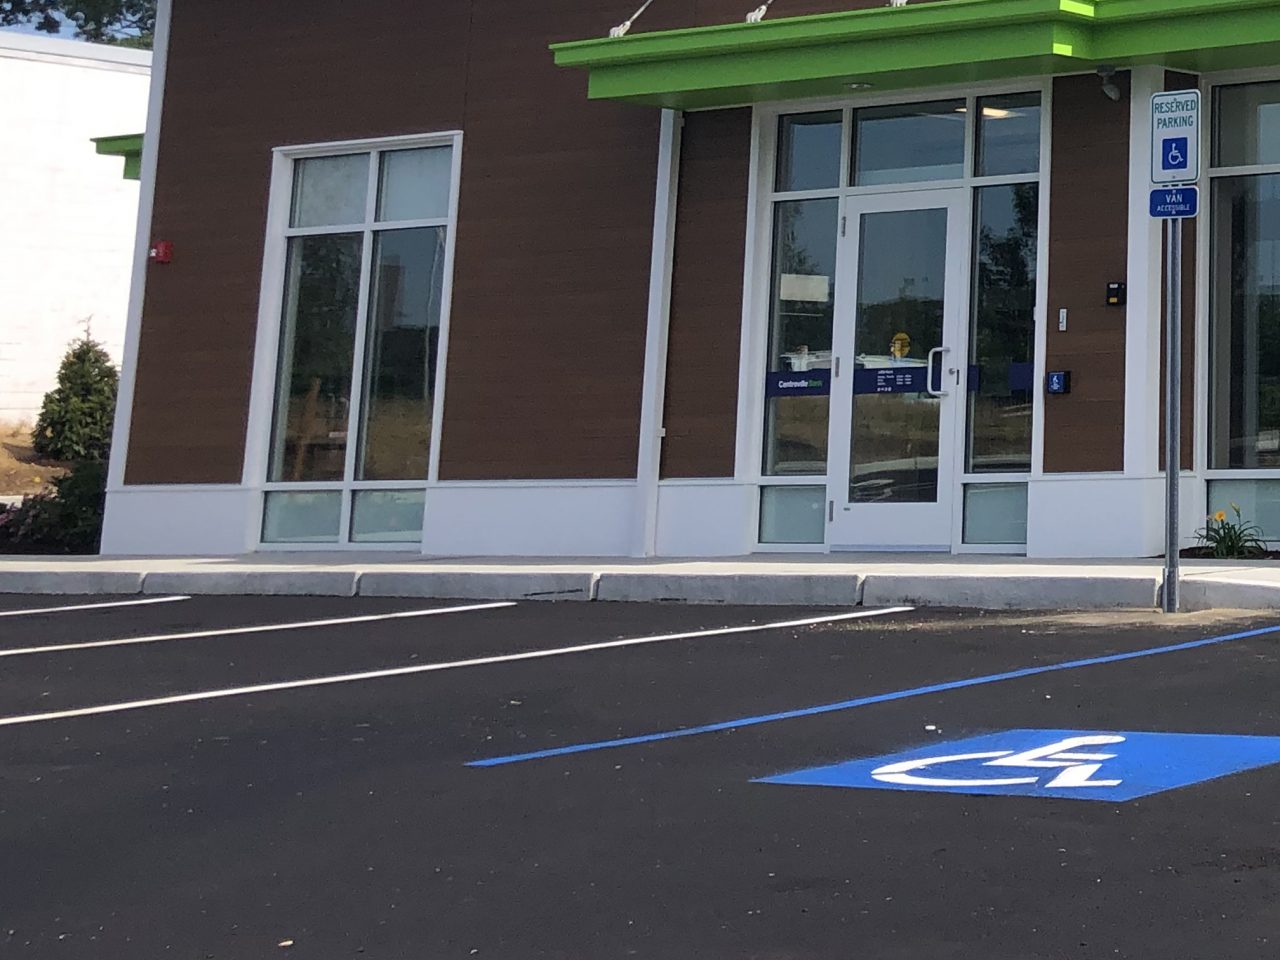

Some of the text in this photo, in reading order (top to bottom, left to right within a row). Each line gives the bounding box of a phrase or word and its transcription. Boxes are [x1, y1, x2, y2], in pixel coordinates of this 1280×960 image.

[1154, 100, 1196, 114] RESERVED
[1157, 116, 1194, 129] PARKING
[1165, 194, 1183, 203] VAN
